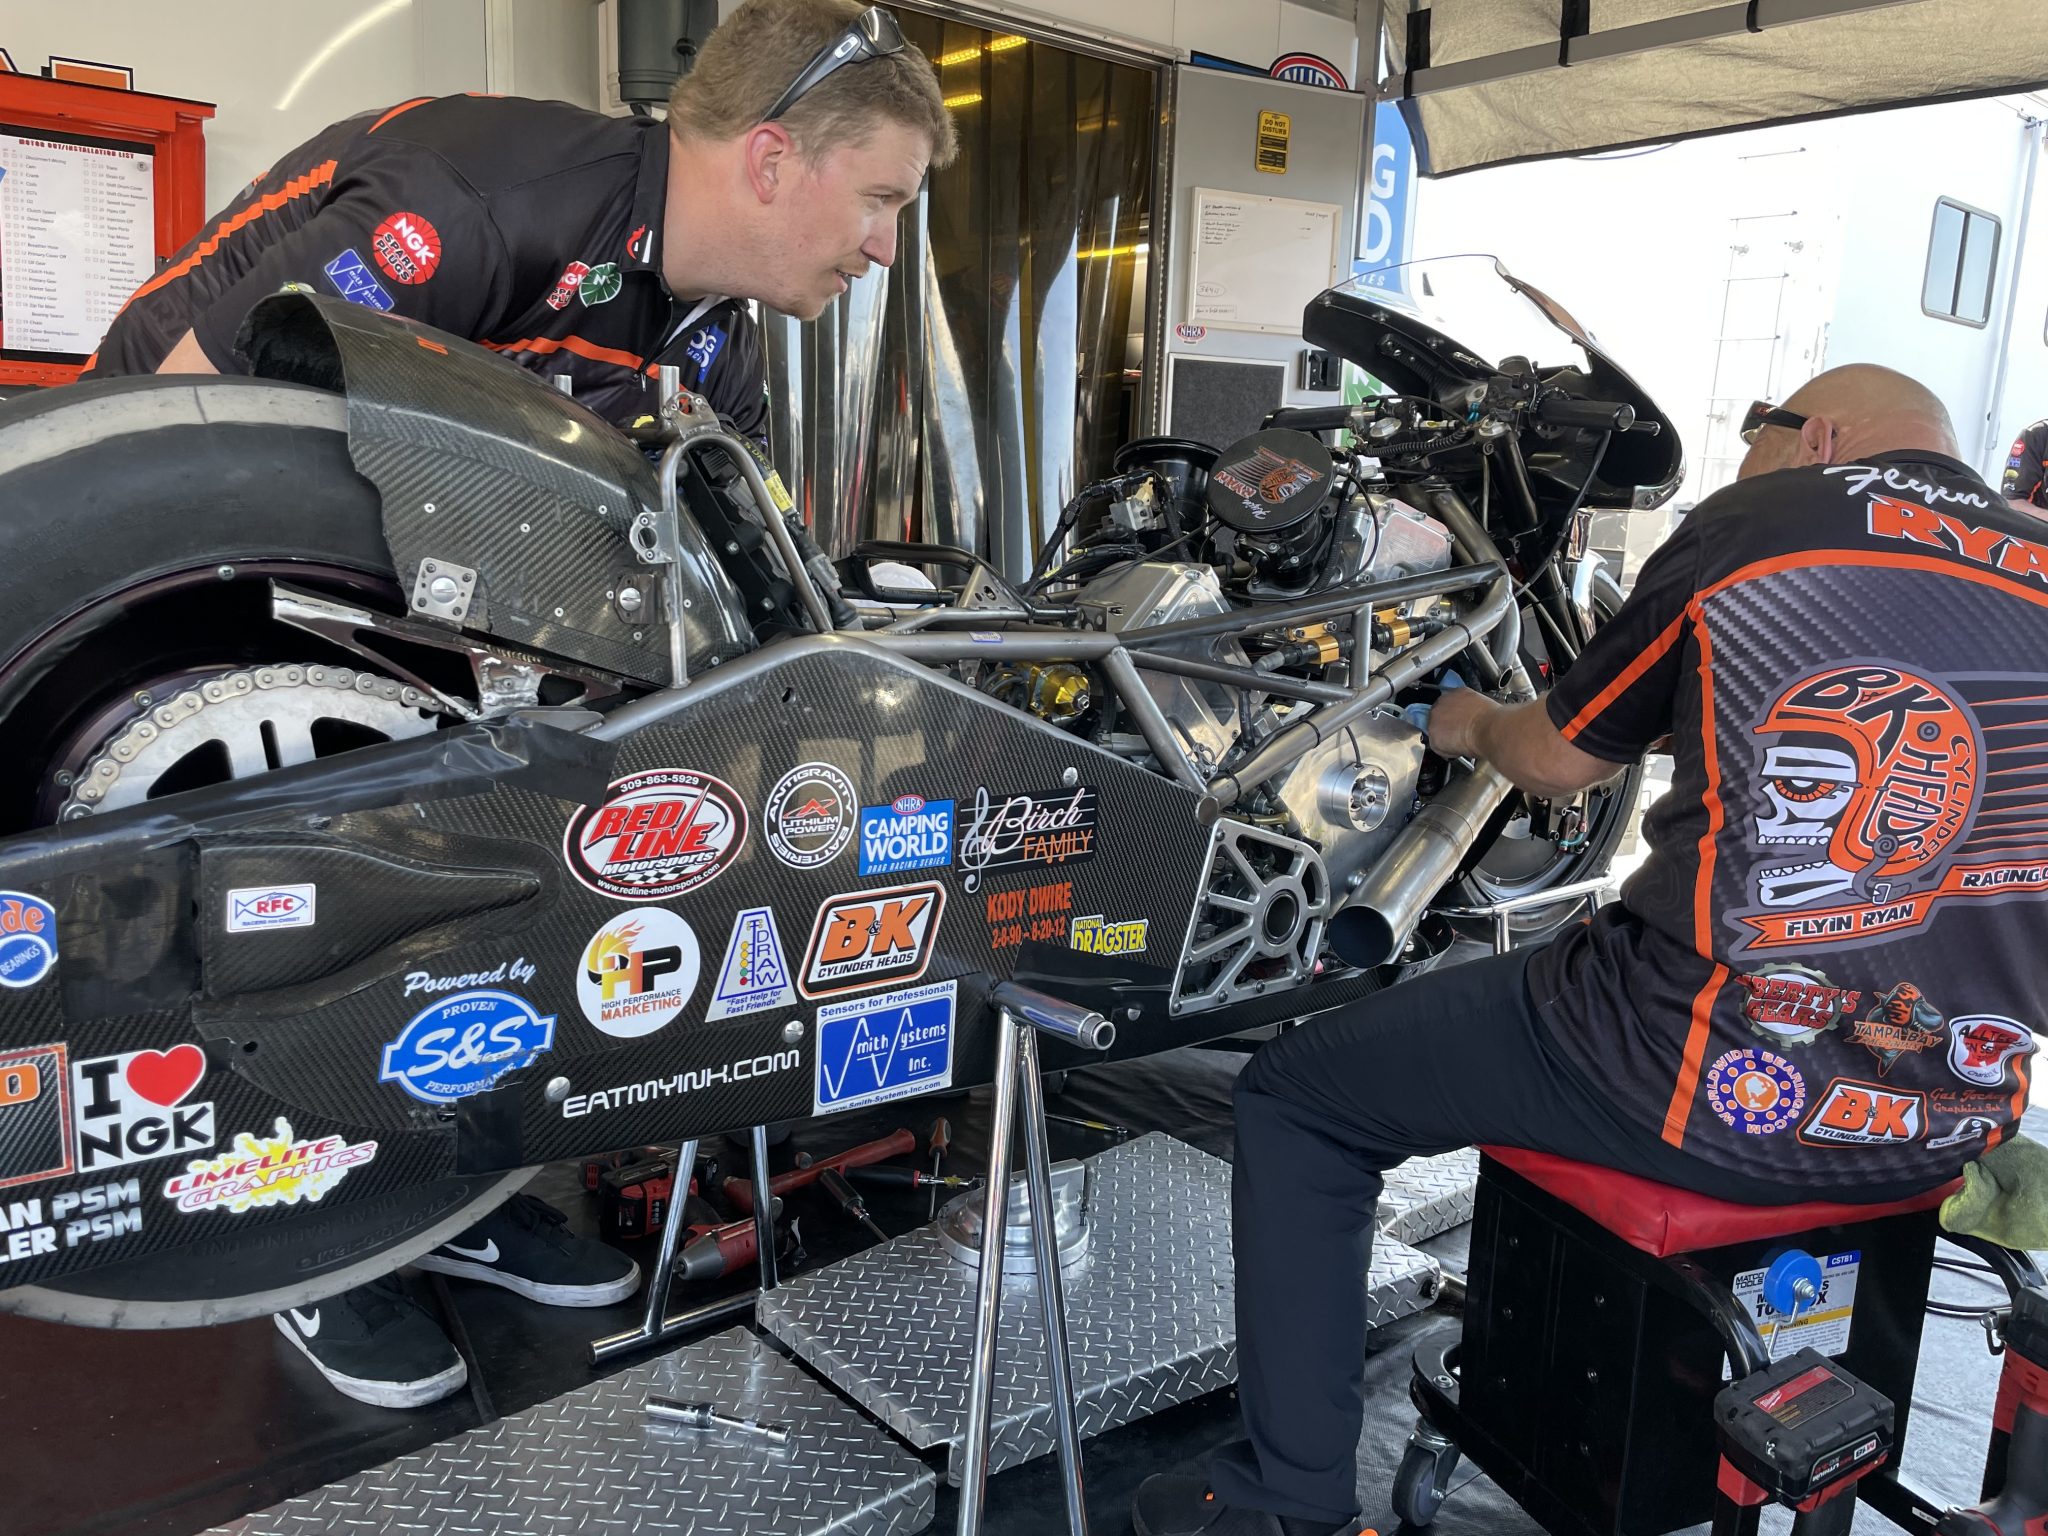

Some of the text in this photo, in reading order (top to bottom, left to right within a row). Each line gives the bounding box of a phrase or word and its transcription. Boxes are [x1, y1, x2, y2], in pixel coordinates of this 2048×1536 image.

[1262, 125, 1287, 135] DISTURB
[1274, 120, 1286, 128] NOT
[119, 151, 135, 160] LIST
[384, 232, 421, 276] SPARK
[394, 217, 435, 266] NGK
[375, 238, 411, 282] PLUGS
[1180, 325, 1202, 338] NHRA
[620, 774, 700, 794] 309-863-5929
[768, 767, 854, 824] ANTIGRAVITY
[1874, 741, 1950, 852] HEADS
[1905, 735, 1972, 863] CYLINDER
[895, 796, 923, 811] NHRA
[584, 799, 686, 851] RED
[608, 809, 719, 864] LINE
[782, 816, 839, 828] LITHIUM
[785, 824, 836, 835] POWER
[864, 812, 949, 839] CAMPING
[980, 787, 1087, 855] Birch
[768, 825, 850, 865] BATTERIES
[865, 833, 948, 863] WORLD
[1023, 829, 1093, 864] FAMILY
[596, 861, 721, 896] www.redline-motorsports.com
[601, 851, 719, 877] Motorsports
[867, 857, 945, 874] DRAG RACING SERIES
[256, 897, 294, 914] RFC
[987, 881, 1072, 924] KODY DWIRE
[1861, 902, 1915, 929] RYAN
[820, 897, 931, 967] B&K
[991, 924, 1022, 950] 2-8-90
[1031, 915, 1066, 943] 8-20-12
[1073, 923, 1146, 954] DRAGSTER
[1075, 918, 1103, 930] NATIONAL
[1, 944, 41, 976] BEARINGS
[756, 929, 779, 986] DRAW
[817, 952, 914, 979] CYLINDER HEADS
[404, 956, 537, 998] Powered by
[442, 1001, 499, 1020] PROVEN
[601, 988, 682, 1009] HIGH PERFORMANCE
[601, 995, 682, 1022] MARKETING
[725, 1006, 745, 1015] Fast
[749, 992, 769, 1005] Help
[770, 989, 782, 998] for
[820, 983, 955, 1018] Sensors for Professionals
[1734, 974, 1862, 1014] BERTY'S
[1746, 1000, 1833, 1029] GEARS
[407, 1015, 528, 1078] S&S
[1855, 1022, 1901, 1040] TAMPA
[1906, 1031, 1943, 1047] BAY
[423, 1062, 517, 1095] PERFORMANCE
[908, 1057, 931, 1073] Inc.
[81, 1059, 121, 1121] I
[562, 1049, 800, 1119] EATMYINK.COM
[824, 1080, 941, 1115] www.Smith-Systems-Inc.com
[1706, 1048, 1806, 1135] WORLDWIDE BEARINGS.COM
[1819, 1087, 1916, 1139] B&K
[80, 1105, 211, 1168] NGK
[1813, 1127, 1869, 1143] CYLINDER
[169, 1137, 340, 1195] LIMELITE
[182, 1142, 376, 1209] GRAPHICS
[52, 1178, 140, 1220] PSM
[66, 1206, 143, 1248] PSM
[1831, 1254, 1853, 1265] CSTB1
[1735, 1271, 1765, 1284] MATCO
[1736, 1280, 1764, 1290] TOOLS
